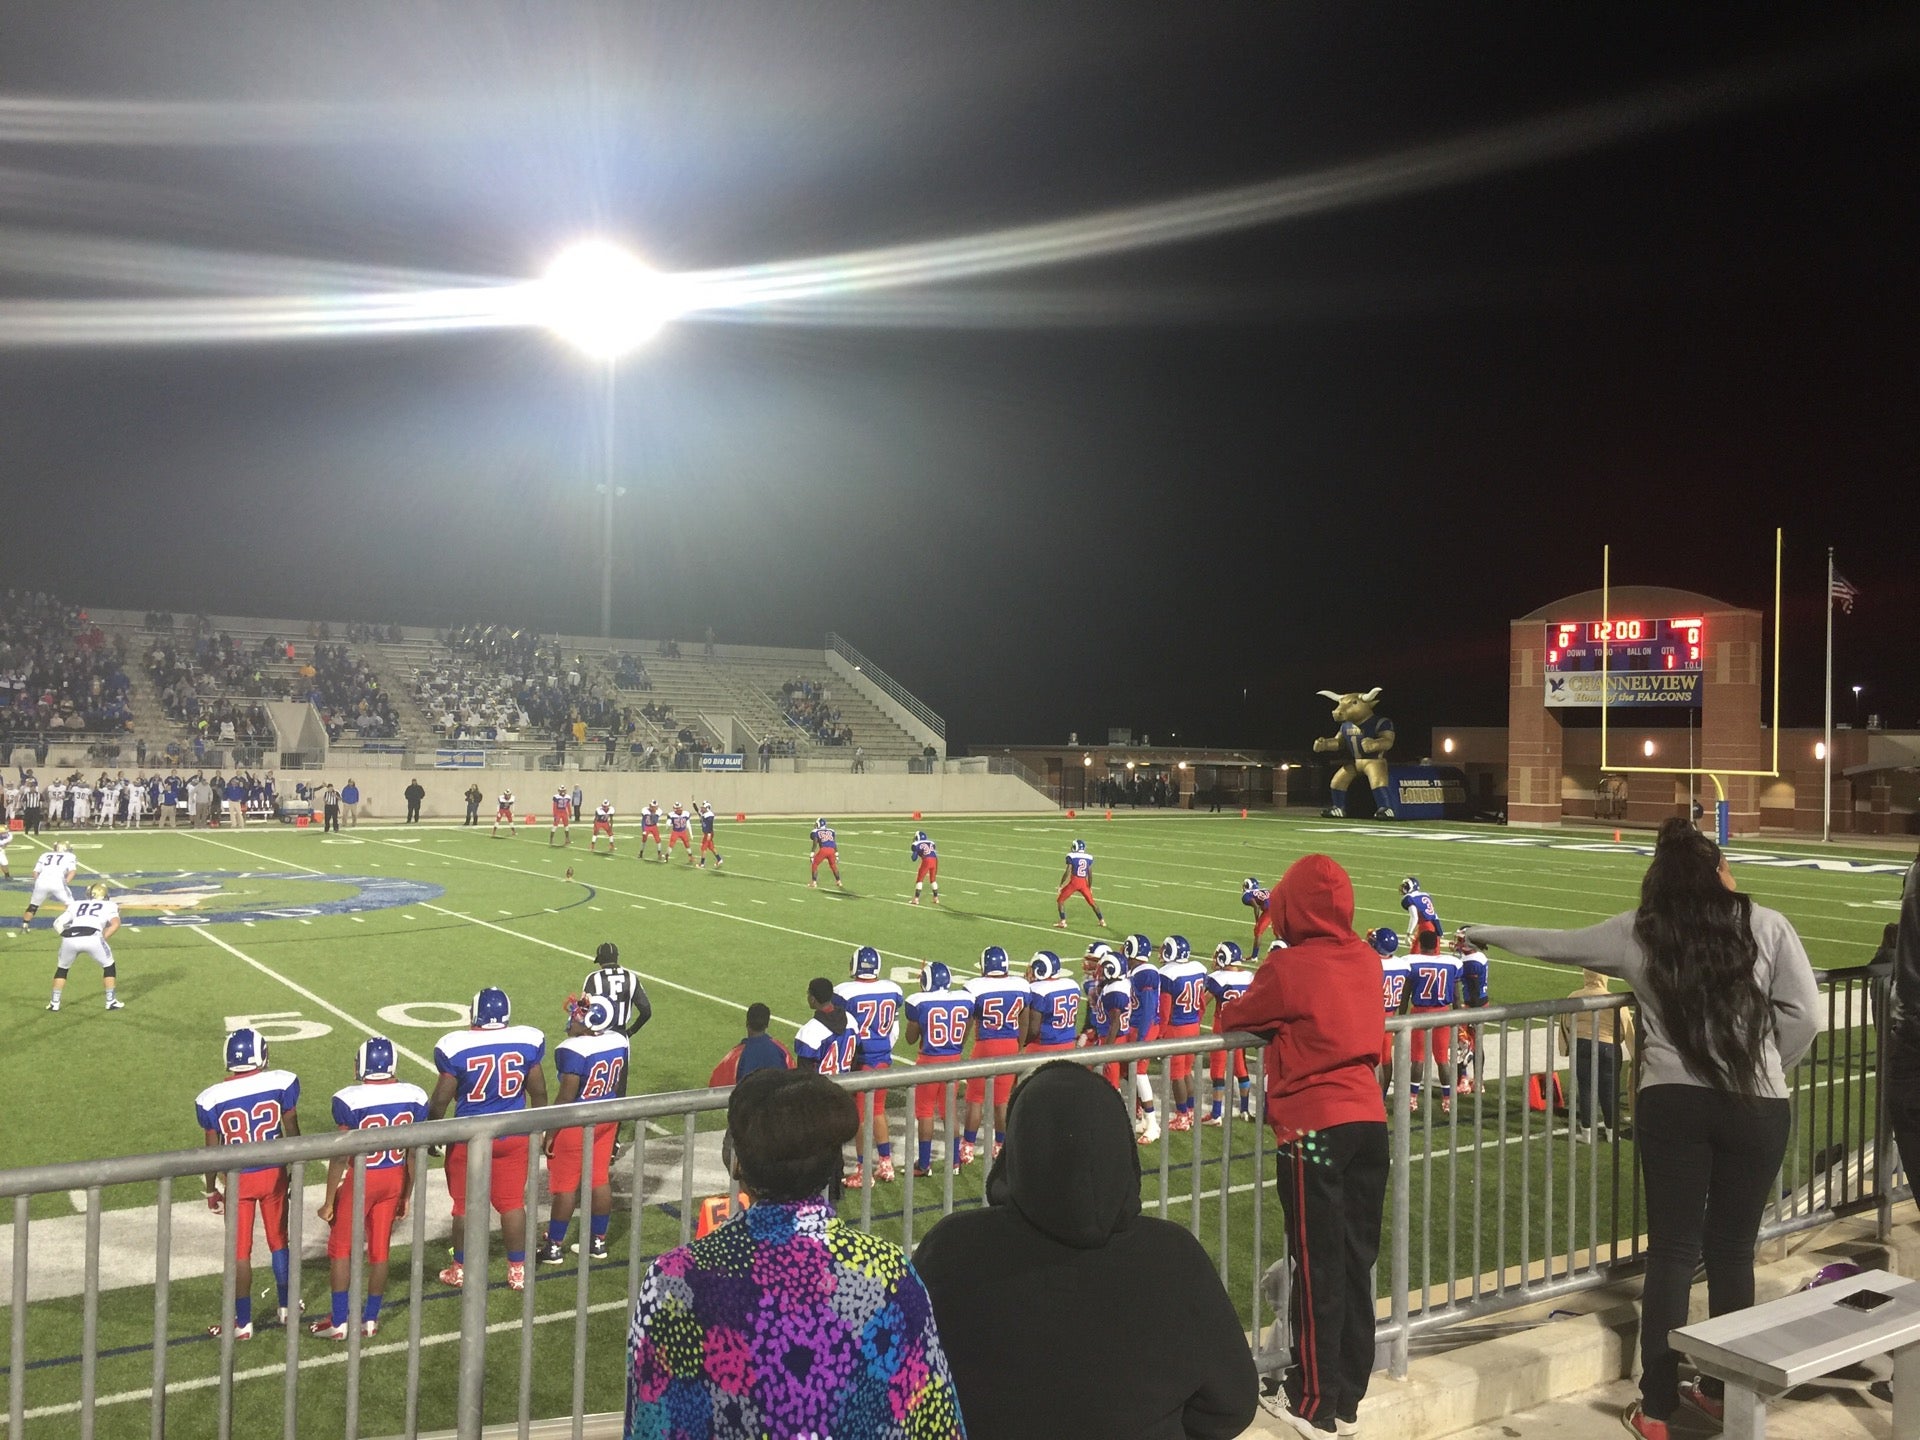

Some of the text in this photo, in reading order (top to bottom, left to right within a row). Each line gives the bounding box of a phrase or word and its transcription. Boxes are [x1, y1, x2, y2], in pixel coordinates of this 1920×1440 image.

[1559, 633, 1569, 648] 0
[1688, 628, 1699, 644] 0
[1549, 651, 1557, 662] 3
[1566, 649, 1586, 657] DOWN
[1594, 648, 1603, 656] TO
[1627, 647, 1652, 656] BALL ON
[1690, 647, 1699, 659] 3
[1667, 655, 1673, 669] 1
[1569, 675, 1698, 692] CHANNELVIEW
[1607, 692, 1617, 704] of
[1619, 691, 1634, 702] the
[1636, 692, 1692, 702] FALCONS
[725, 757, 742, 765] BLUE
[44, 855, 64, 865] 37
[1077, 859, 1089, 877] 2
[76, 903, 104, 917] 82
[1421, 896, 1435, 916] 3
[607, 975, 626, 1001] F
[1382, 975, 1406, 1008] 42
[1419, 967, 1448, 1000] 71
[1176, 977, 1207, 1014] 40
[857, 999, 898, 1040] 70
[982, 996, 1025, 1030] 54
[1052, 993, 1081, 1030] 52
[927, 1006, 969, 1047] 66
[818, 1035, 857, 1076] 44
[466, 1051, 525, 1103] 76
[581, 1056, 624, 1100] 60
[218, 1099, 282, 1145] 82
